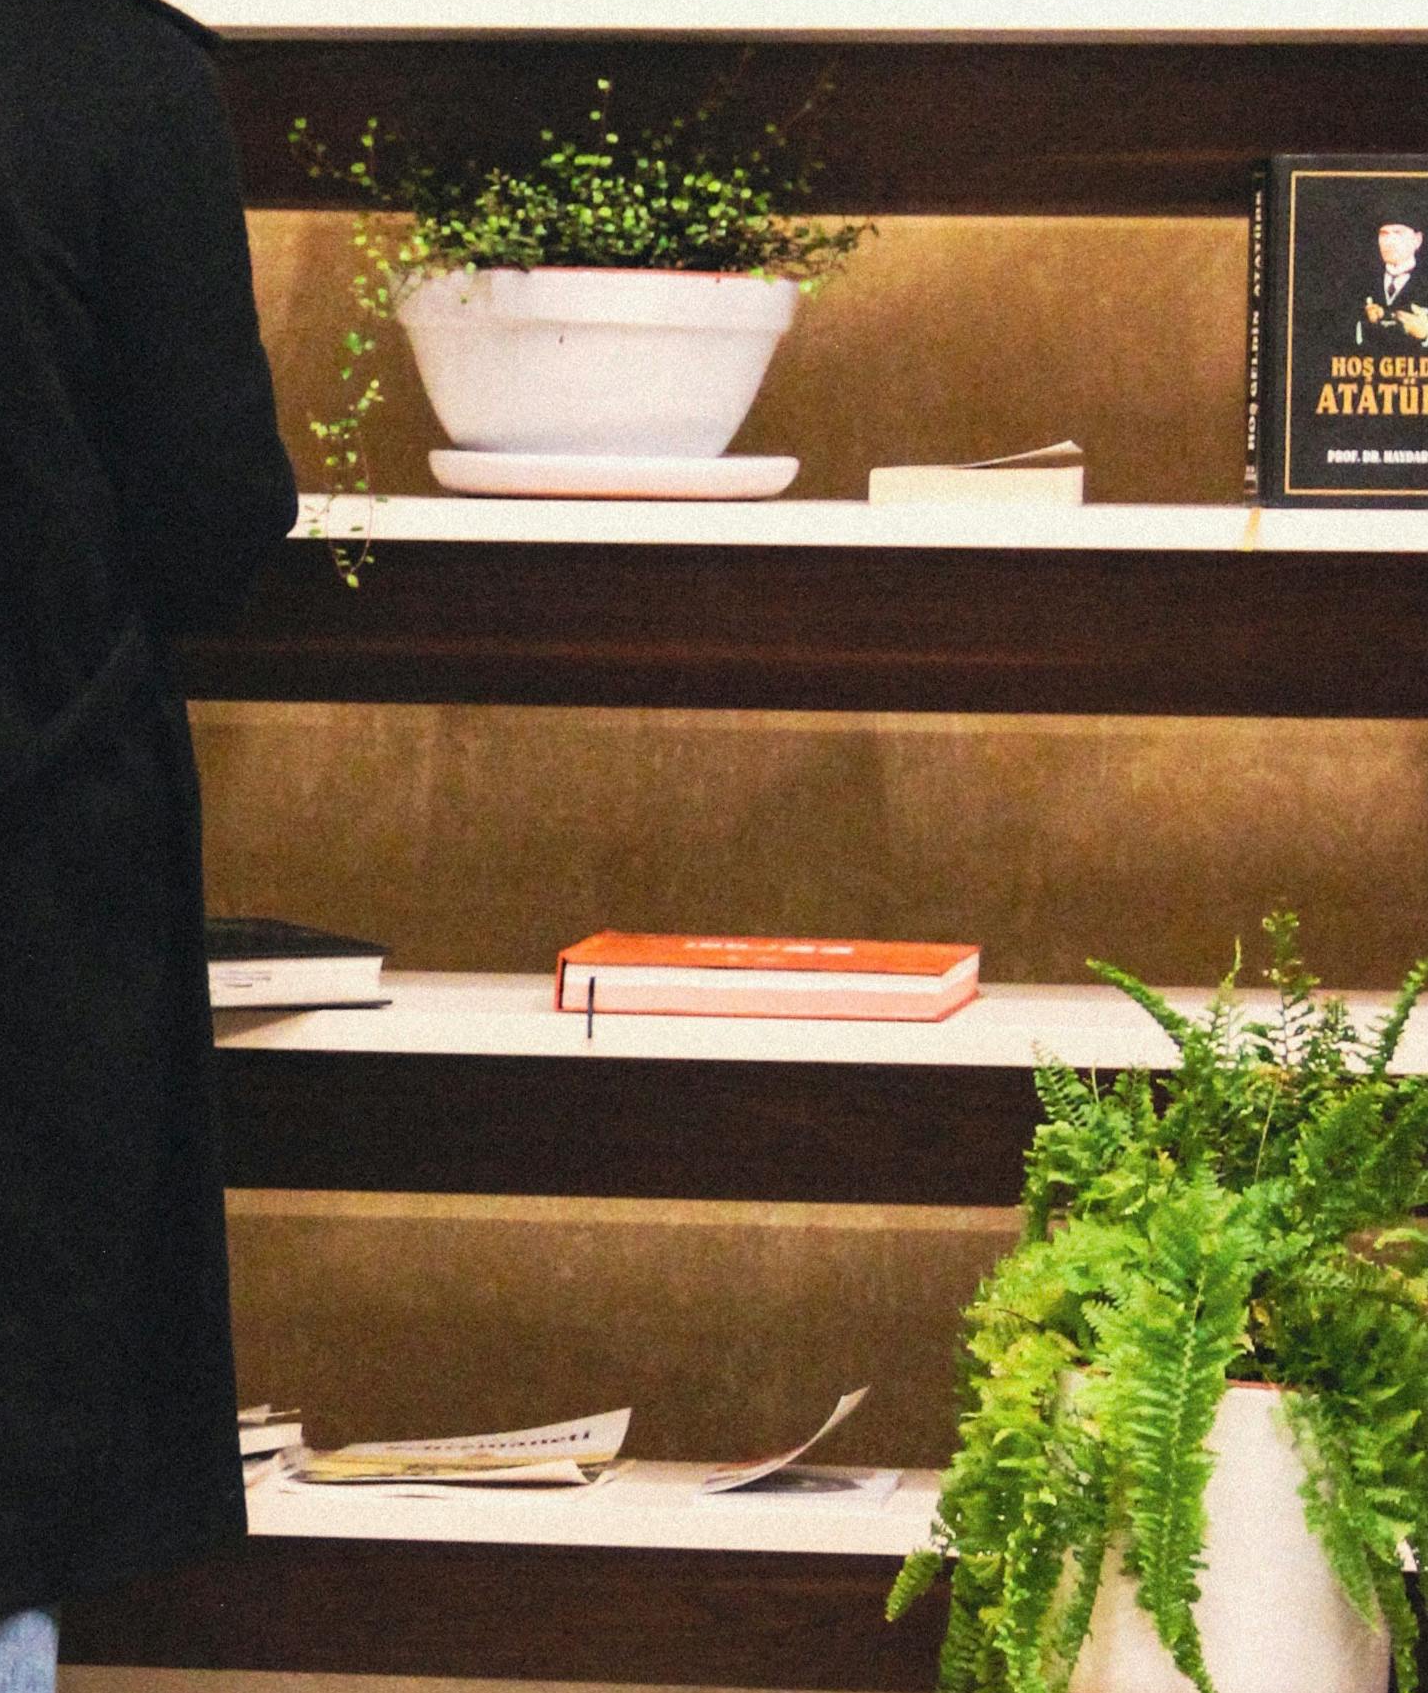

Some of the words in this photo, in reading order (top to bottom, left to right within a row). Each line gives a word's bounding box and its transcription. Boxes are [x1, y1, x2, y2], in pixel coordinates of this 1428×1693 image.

[1331, 356, 1374, 383] HOŞ
[1327, 449, 1361, 463] PROF.
[1362, 449, 1382, 463] DR.
